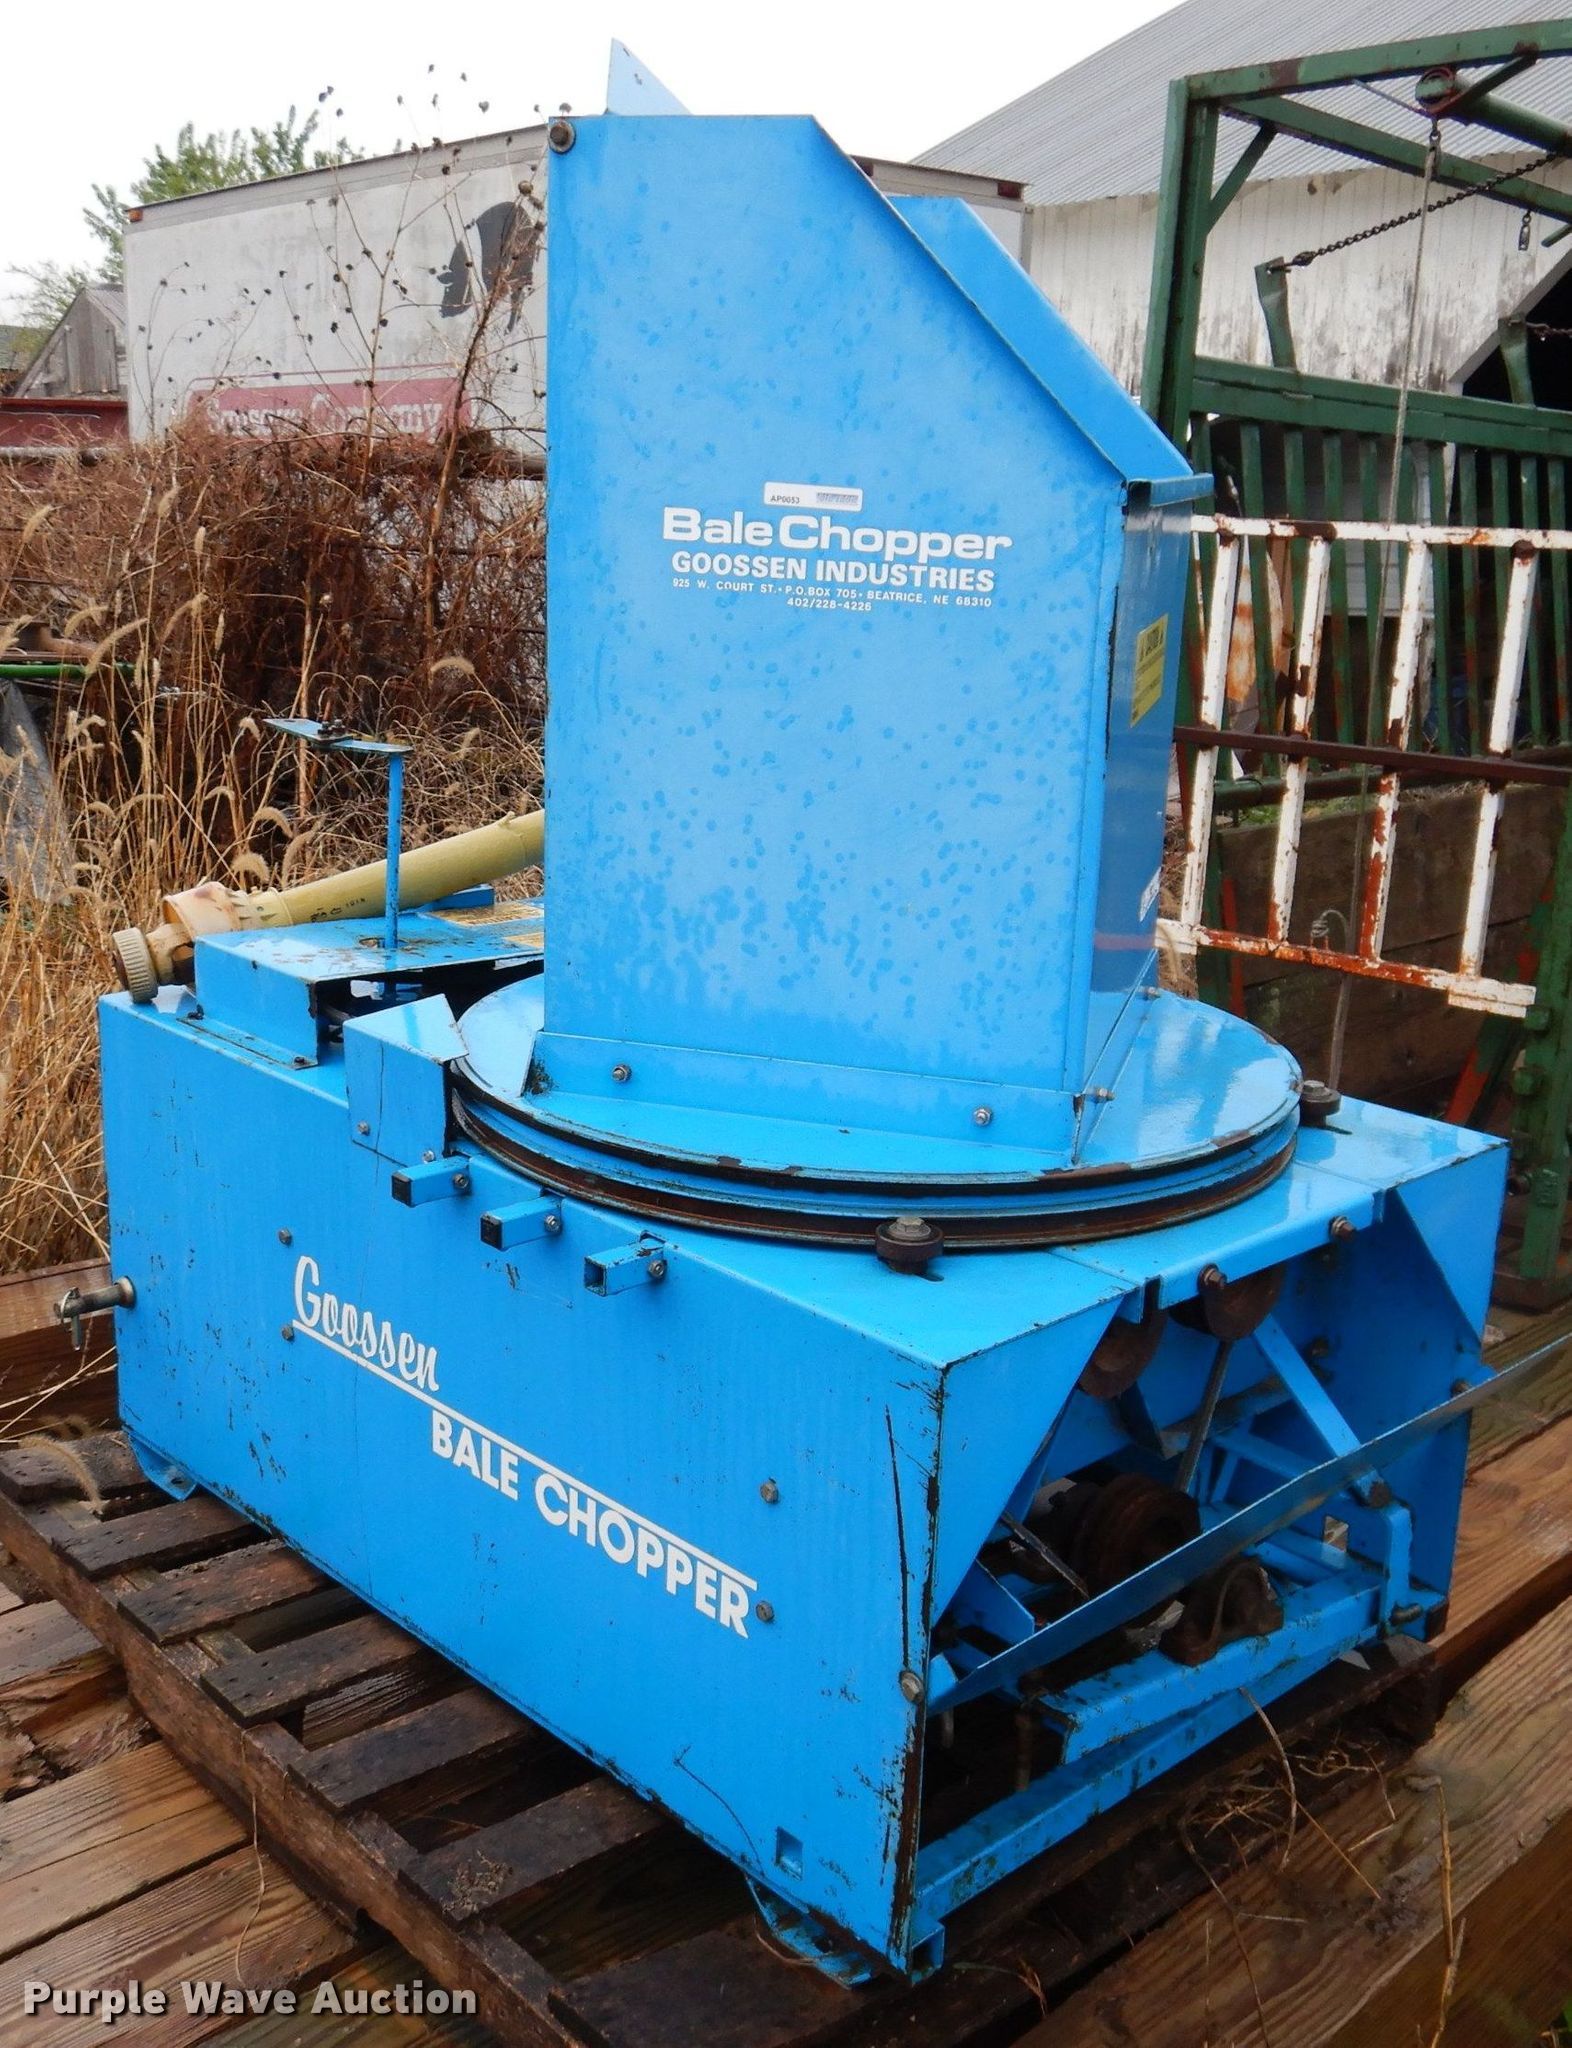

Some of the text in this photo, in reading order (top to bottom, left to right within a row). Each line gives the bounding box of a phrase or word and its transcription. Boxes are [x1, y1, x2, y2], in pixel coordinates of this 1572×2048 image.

[671, 550, 996, 593] GOOSSEN INDUSTRIES
[672, 578, 690, 588] 925
[716, 581, 755, 592] COURT
[836, 588, 857, 599] 705
[933, 594, 949, 605] NE
[786, 597, 873, 612] 402/228-4226
[293, 1255, 440, 1392] Goossen
[431, 1408, 750, 1639] BALE CHOPPER
